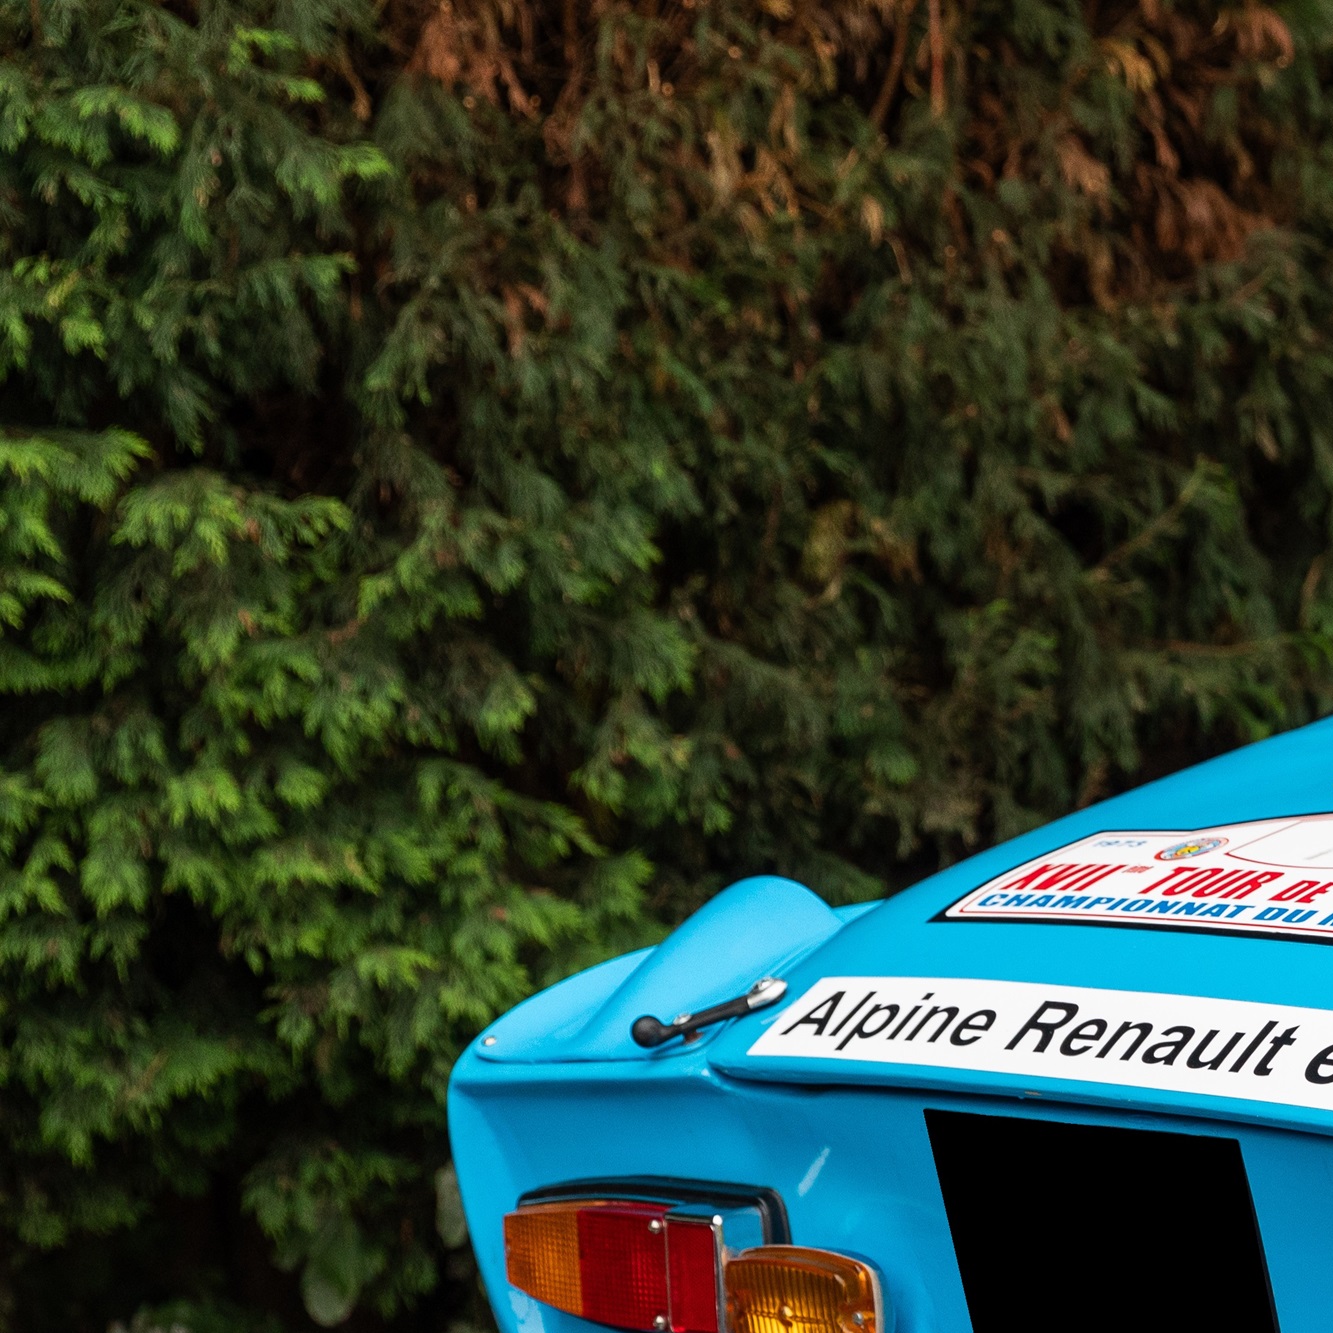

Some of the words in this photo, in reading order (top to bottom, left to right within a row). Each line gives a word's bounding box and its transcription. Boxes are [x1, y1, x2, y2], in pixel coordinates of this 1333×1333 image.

[999, 864, 1128, 892] XVII
[1138, 866, 1285, 901] TOUR
[977, 893, 1255, 920] CHAMPIONNAT
[1252, 906, 1315, 924] DU
[780, 991, 998, 1051] Alpine
[1004, 1000, 1300, 1077] Renault
